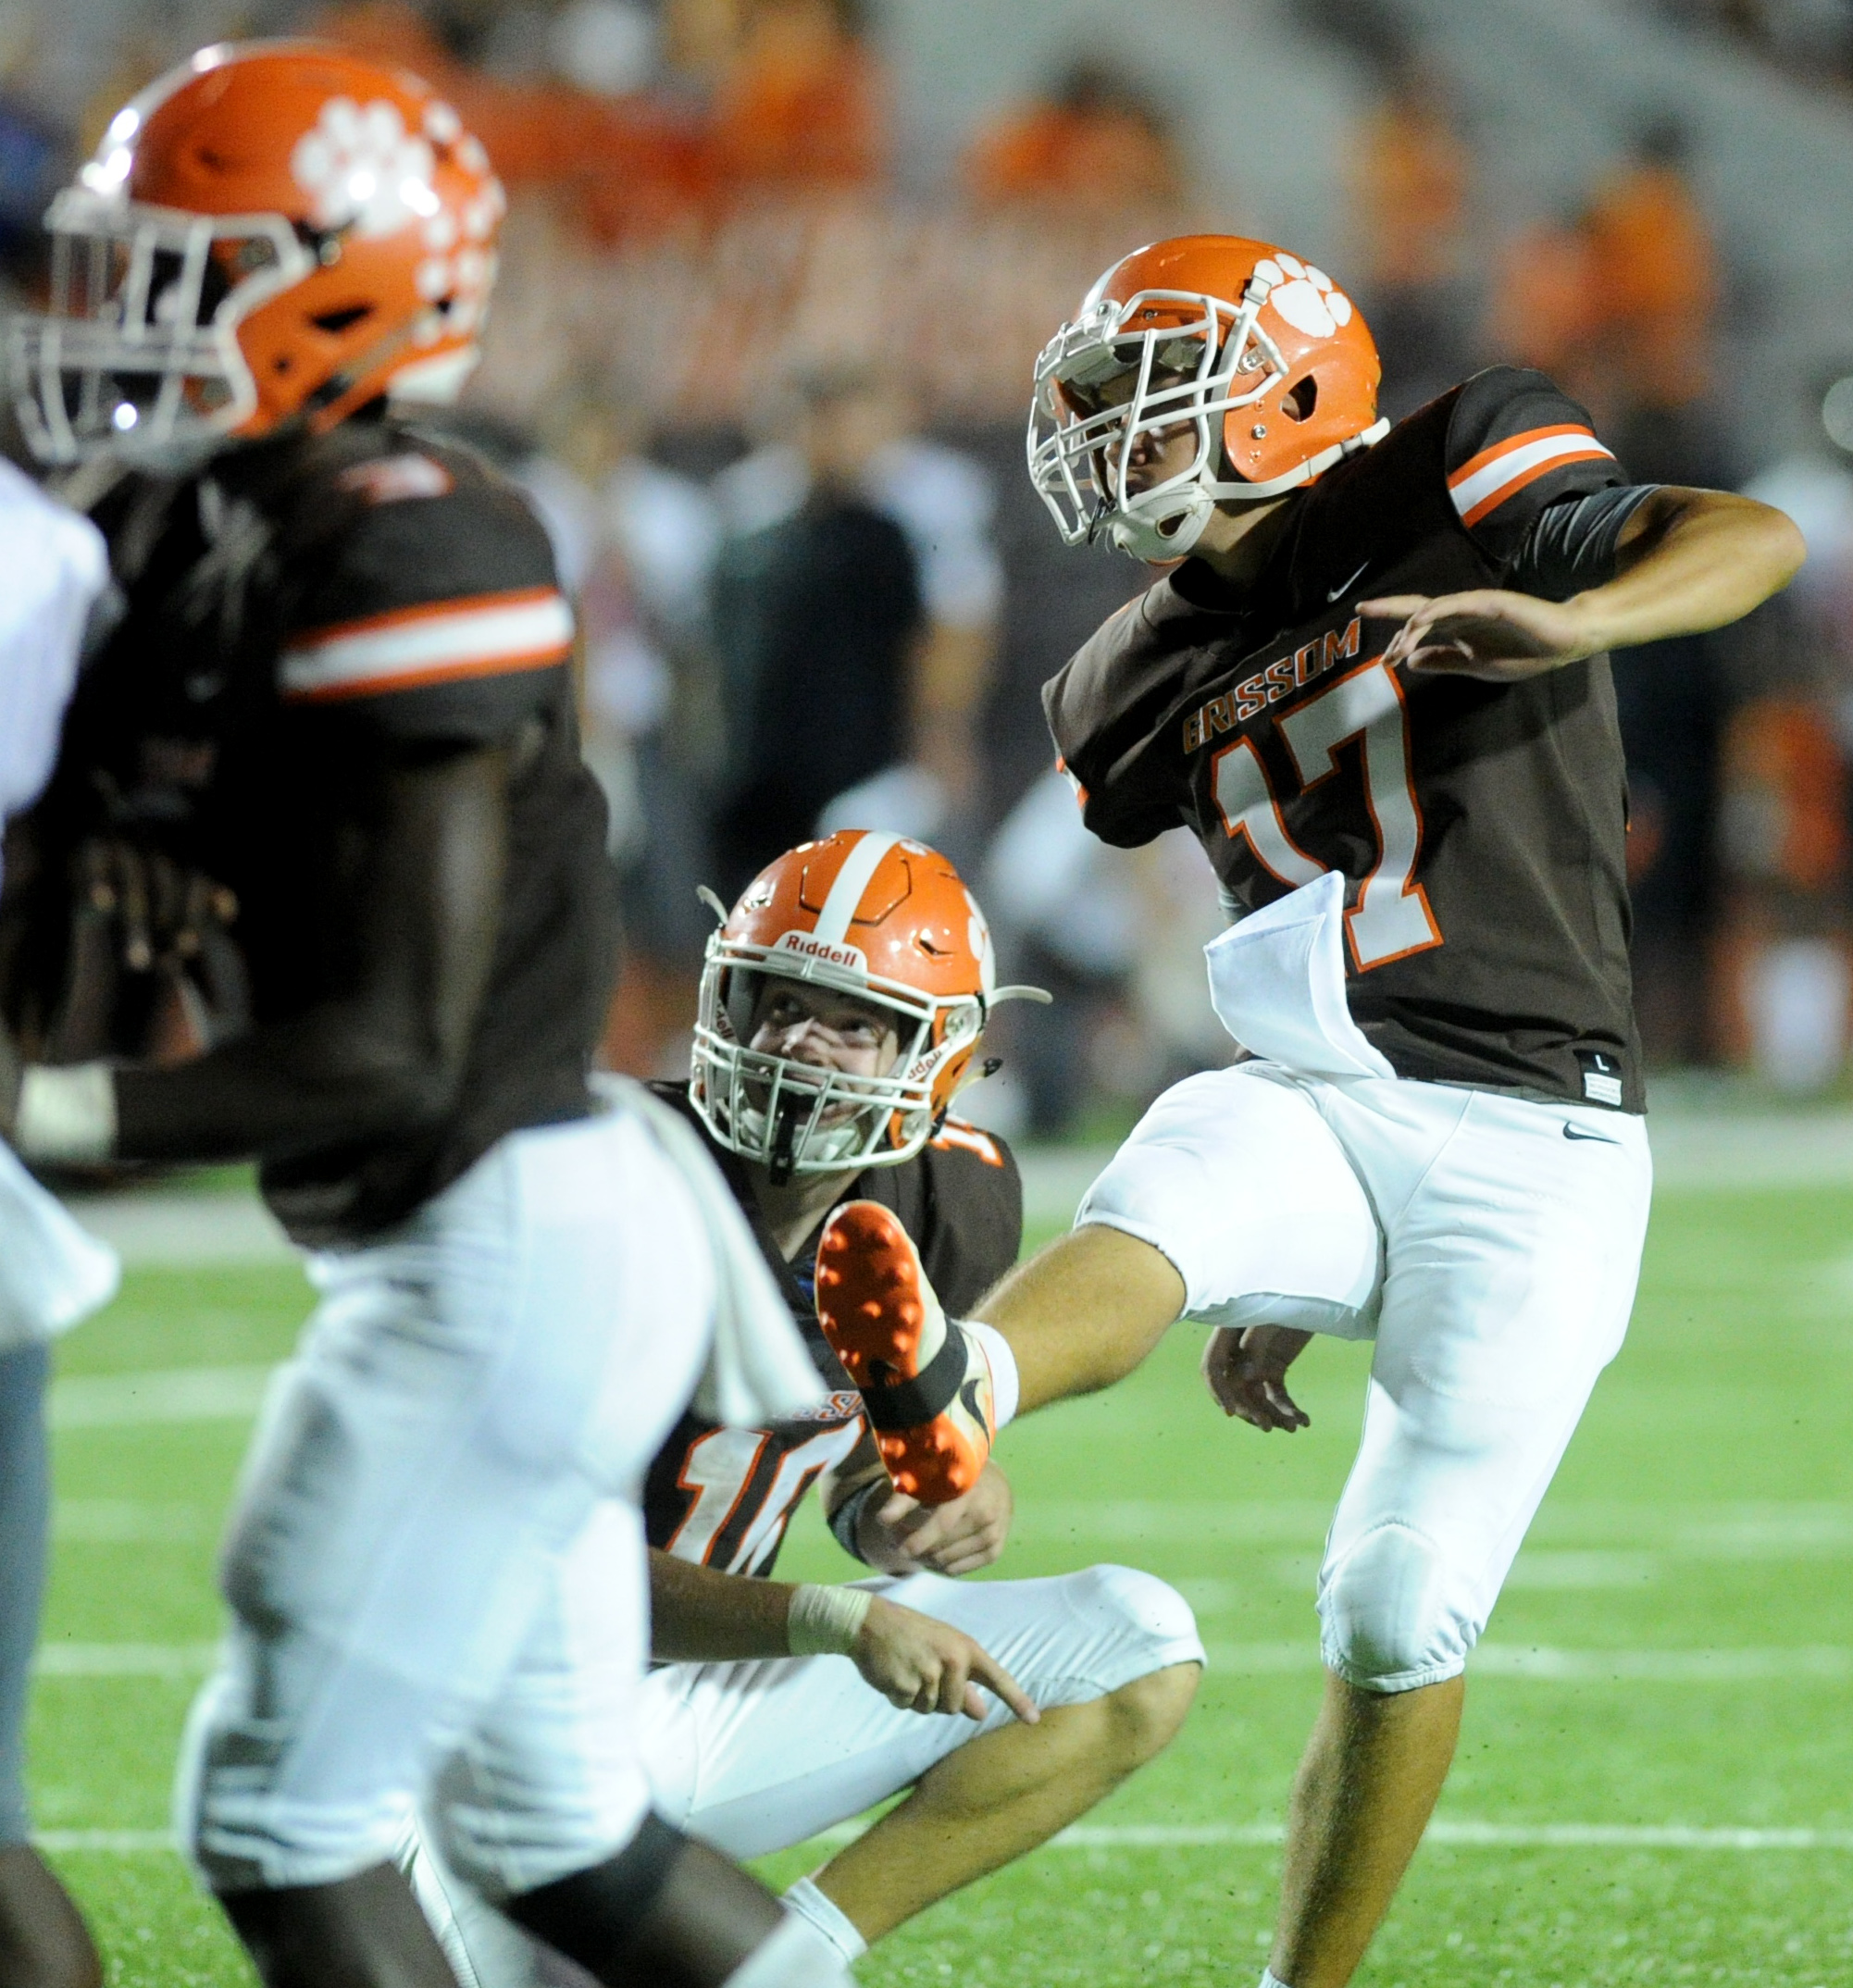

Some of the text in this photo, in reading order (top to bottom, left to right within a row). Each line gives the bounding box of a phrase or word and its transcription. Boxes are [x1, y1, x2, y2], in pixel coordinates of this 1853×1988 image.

[1183, 616, 1361, 754] GRISSOM
[1211, 654, 1443, 972] 17
[786, 934, 857, 967] Riddell
[1595, 1054, 1610, 1072] L
